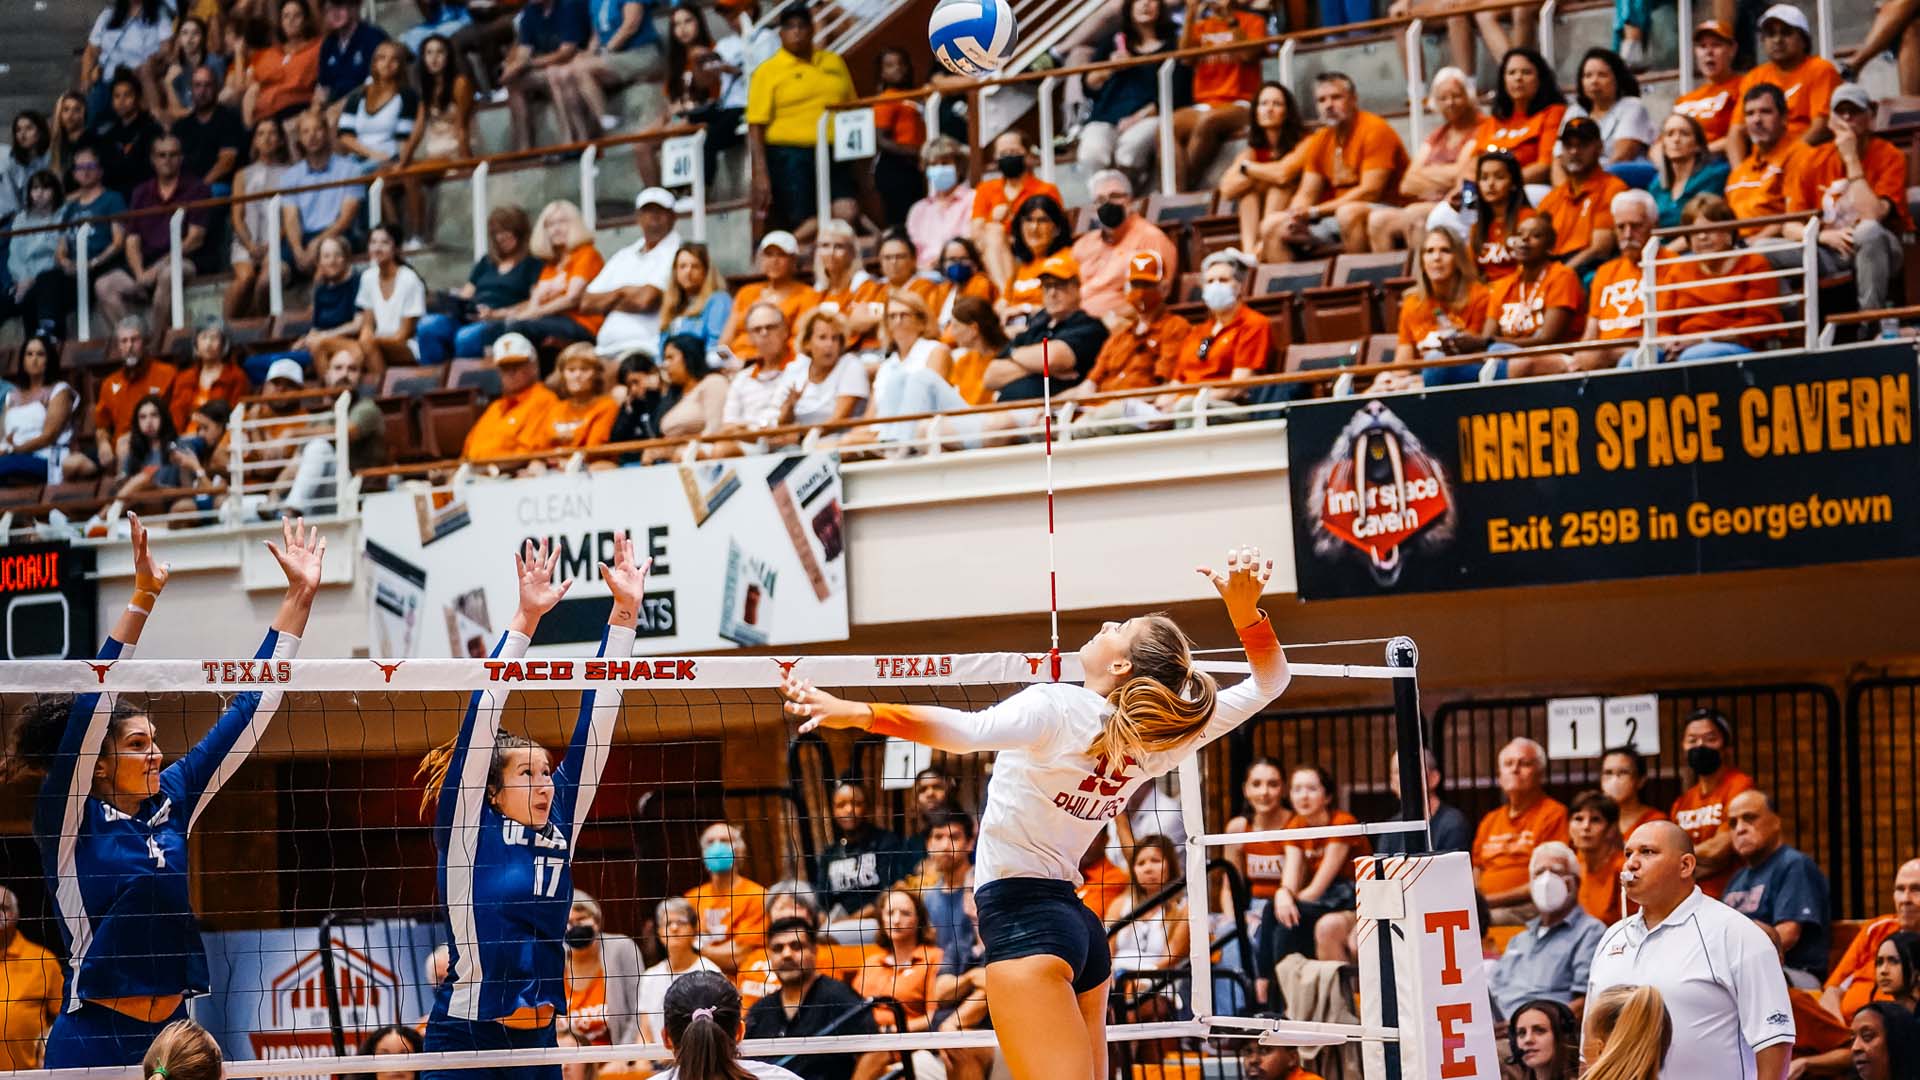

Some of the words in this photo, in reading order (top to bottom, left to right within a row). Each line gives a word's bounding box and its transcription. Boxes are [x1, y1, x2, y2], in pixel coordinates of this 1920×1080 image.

[1458, 406, 1580, 483] INNER
[1595, 392, 1724, 471] SPACE
[1739, 373, 1912, 458] CAVERN
[517, 493, 593, 523] CLEAN
[1352, 508, 1418, 538] cavern
[1487, 513, 1553, 553] Exit
[1560, 507, 1640, 548] 259B
[1648, 505, 1679, 541] in
[1686, 493, 1893, 540] Georgetown
[519, 526, 670, 585] IMPE
[636, 597, 673, 631] ATS
[202, 659, 291, 684] TEXAS
[484, 661, 574, 681] TACO
[585, 659, 696, 681] SHACK
[875, 655, 952, 678] TEXAS
[1570, 720, 1577, 750] 1
[1625, 717, 1637, 748] 2
[1053, 791, 1125, 820] PHILLIPS
[533, 855, 565, 897] 17
